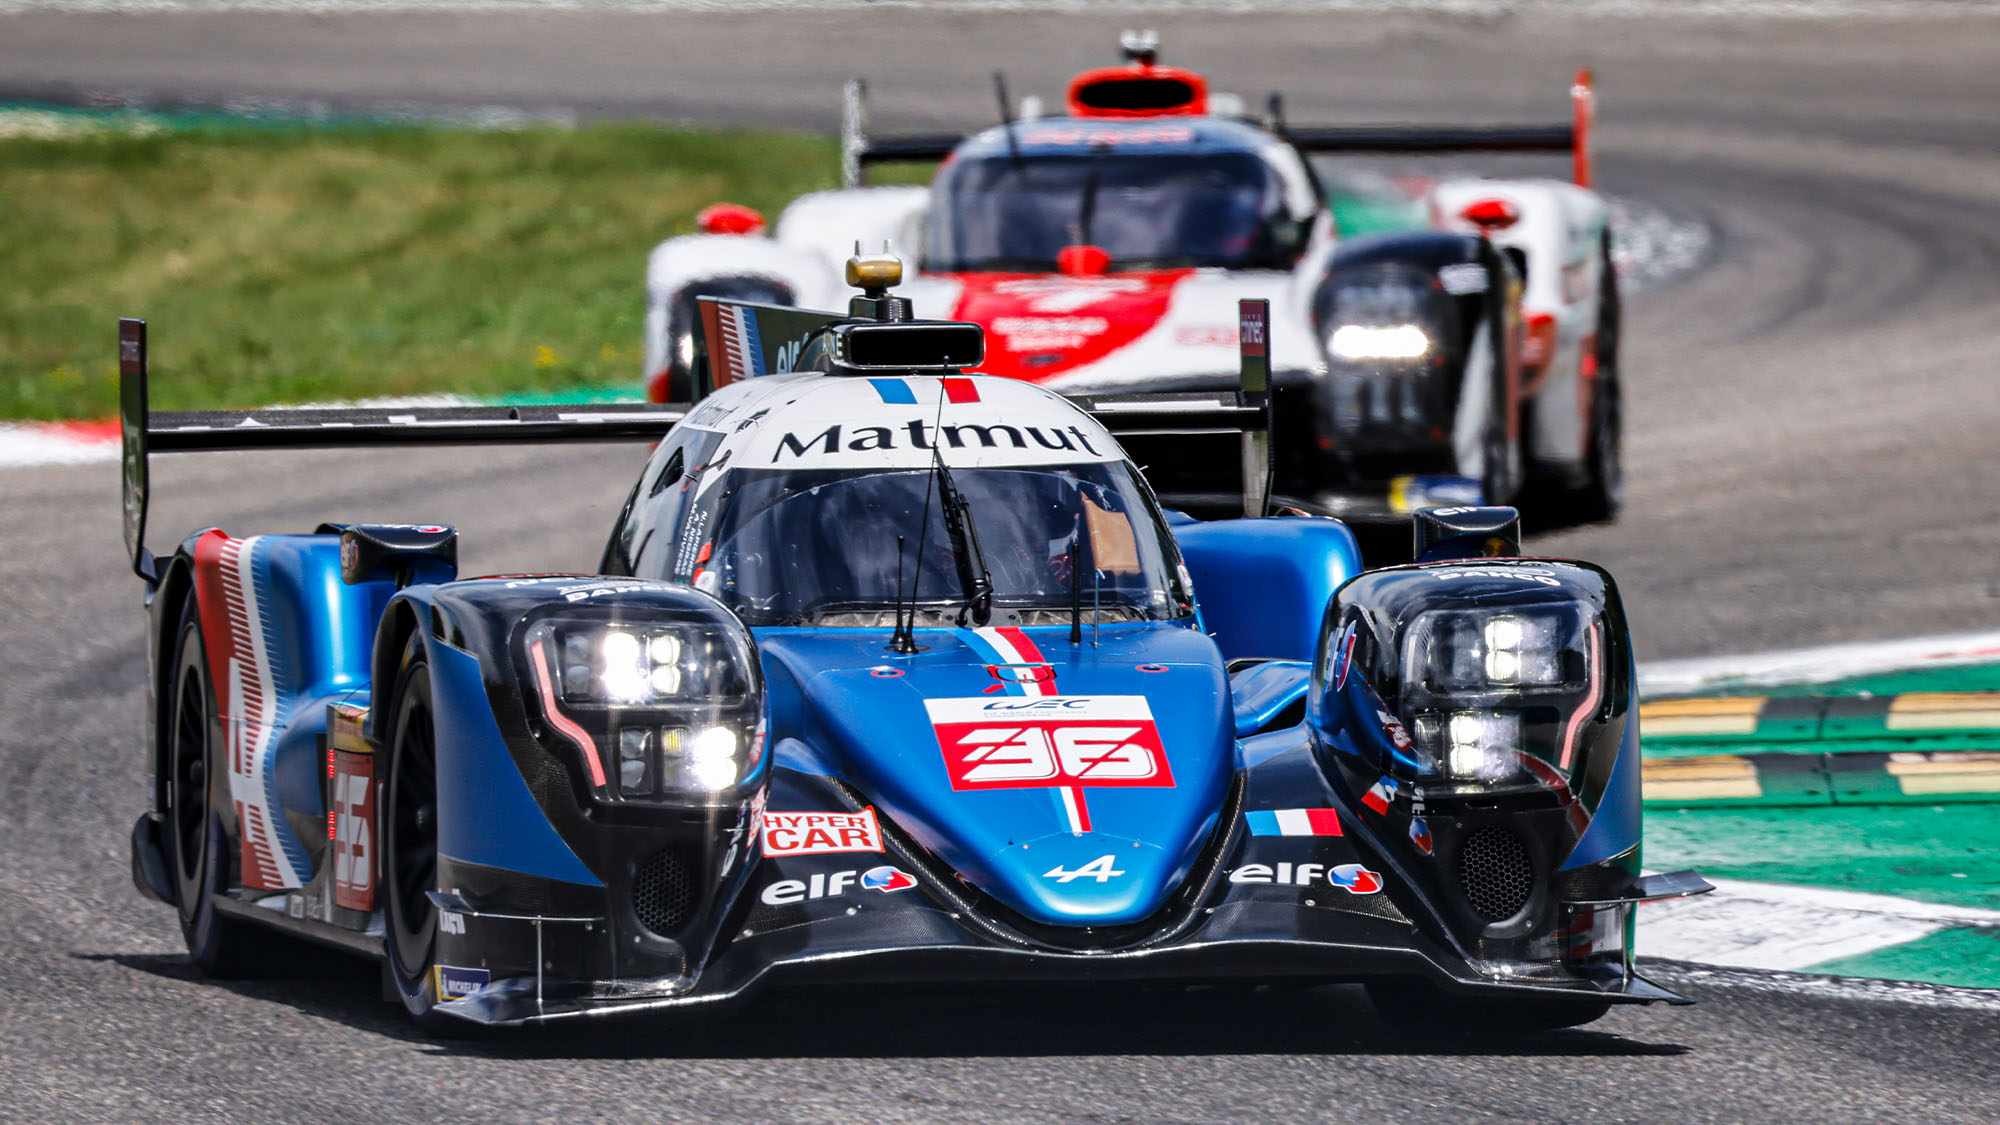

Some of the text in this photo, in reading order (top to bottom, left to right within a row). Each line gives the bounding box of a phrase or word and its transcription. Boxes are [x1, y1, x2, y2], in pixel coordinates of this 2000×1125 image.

[771, 418, 1103, 463] Matmut
[957, 727, 1158, 782] 36
[763, 815, 868, 829] HYPER
[767, 828, 873, 851] CAR
[761, 870, 857, 905] elf
[1228, 862, 1324, 885] elf
